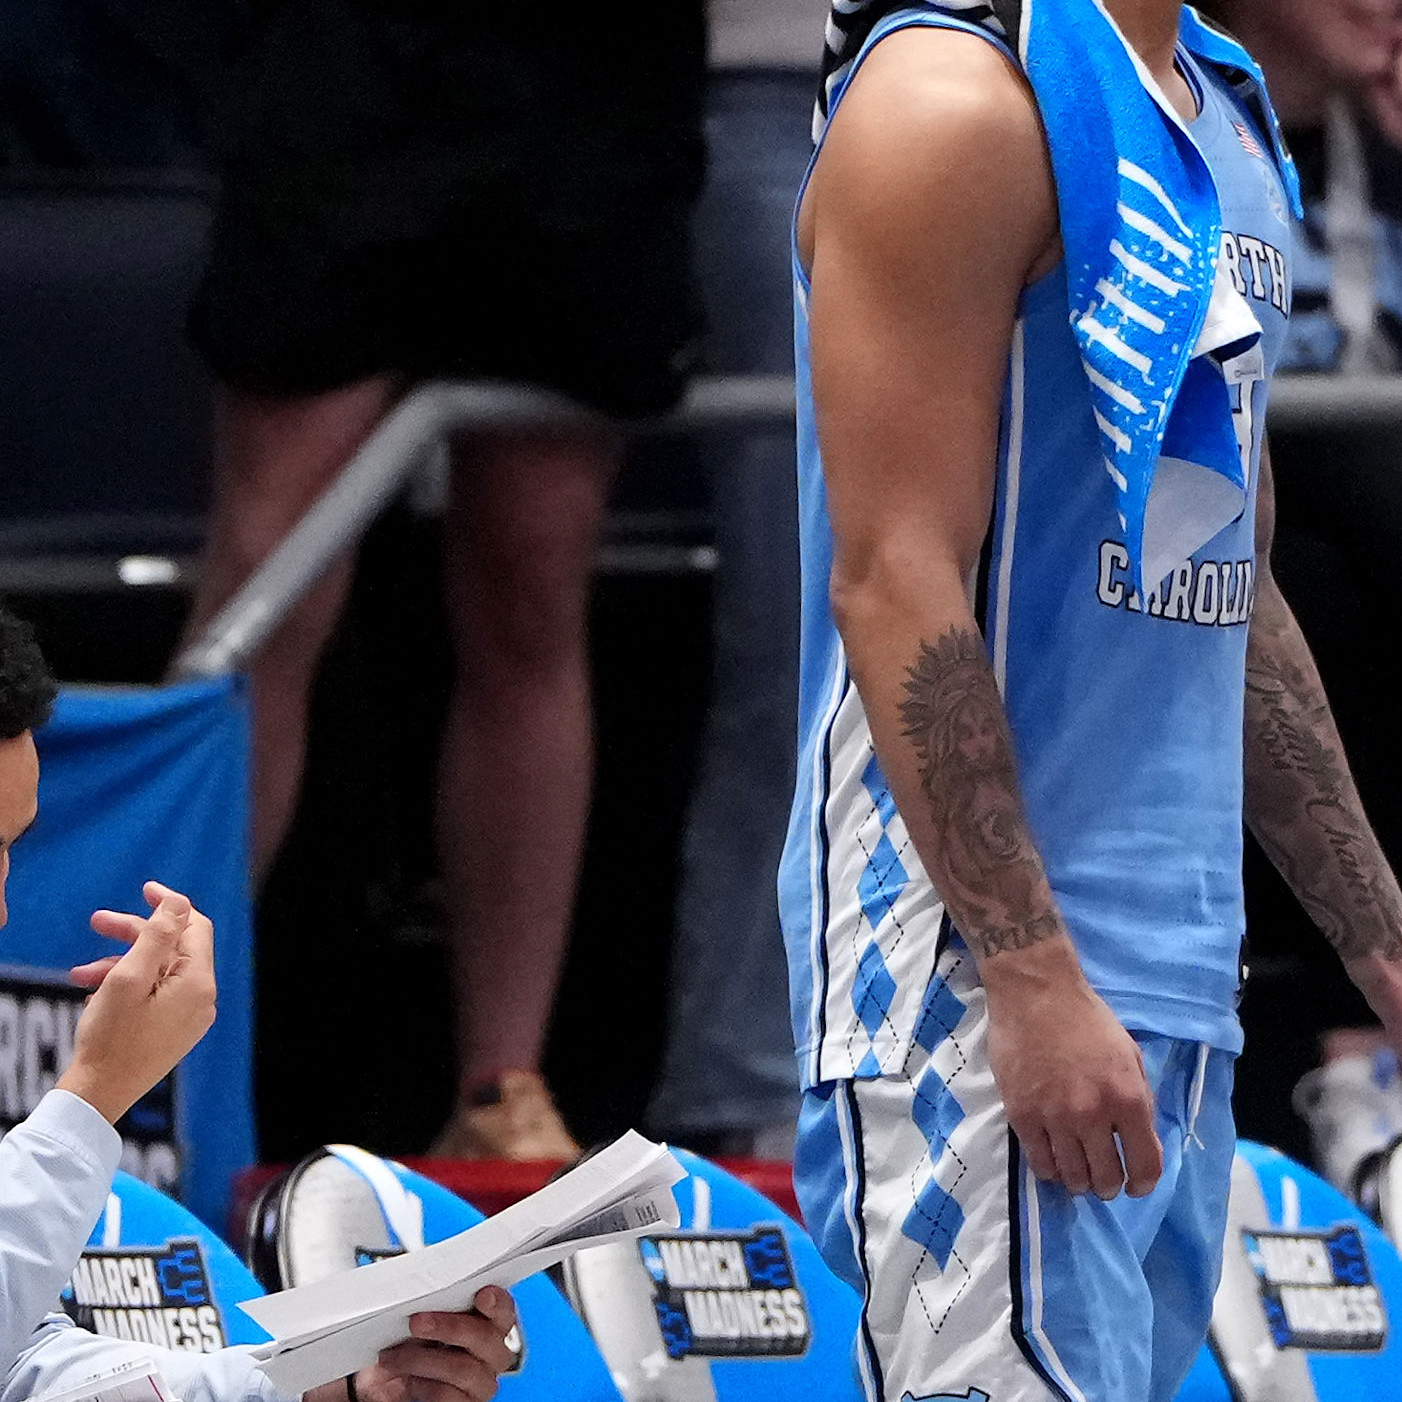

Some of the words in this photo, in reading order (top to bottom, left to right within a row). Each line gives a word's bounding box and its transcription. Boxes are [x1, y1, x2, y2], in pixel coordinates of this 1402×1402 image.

[1221, 229, 1290, 320] RTH
[72, 1255, 162, 1307] MARCH
[92, 1304, 225, 1355] MADNESS
